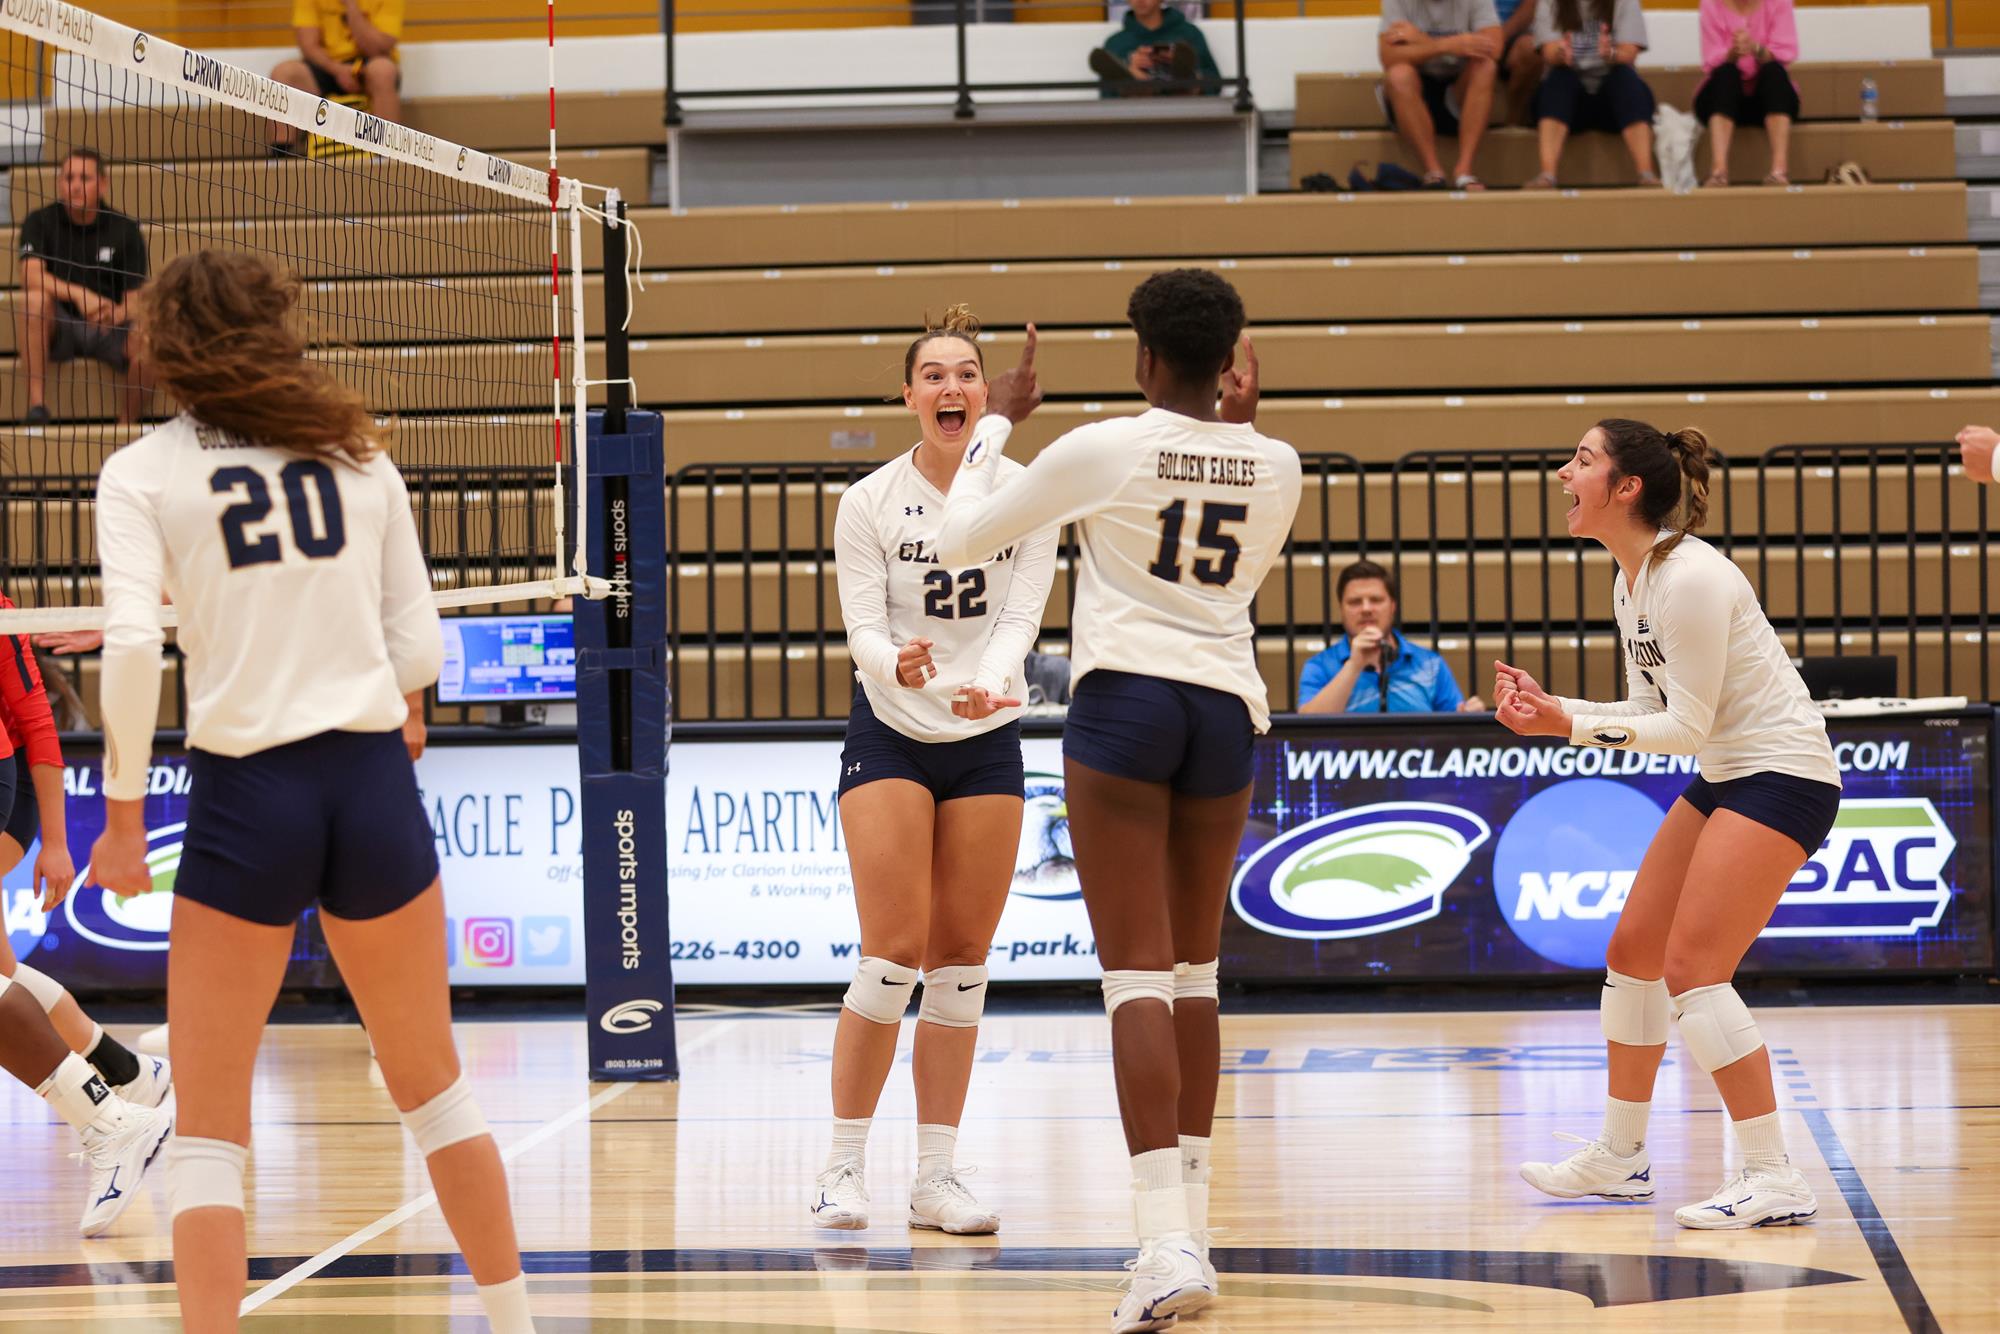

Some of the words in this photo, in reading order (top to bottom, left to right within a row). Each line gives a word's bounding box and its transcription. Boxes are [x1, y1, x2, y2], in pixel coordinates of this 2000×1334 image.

[57, 3, 95, 46] EAGLES
[183, 49, 222, 92] CLARION
[1157, 450, 1206, 484] GOLDEN
[1209, 456, 1256, 488] EAGLES
[208, 458, 347, 572] 20
[611, 499, 629, 552] sports
[1148, 497, 1250, 588] 15
[923, 567, 988, 620] 22
[418, 788, 524, 858] AGLE
[683, 785, 848, 854] APARTM
[613, 809, 638, 881] sports
[703, 863, 727, 881] for
[732, 863, 786, 877] Clarion
[750, 883, 761, 897] &
[767, 883, 832, 899] Working
[617, 883, 641, 970] imports
